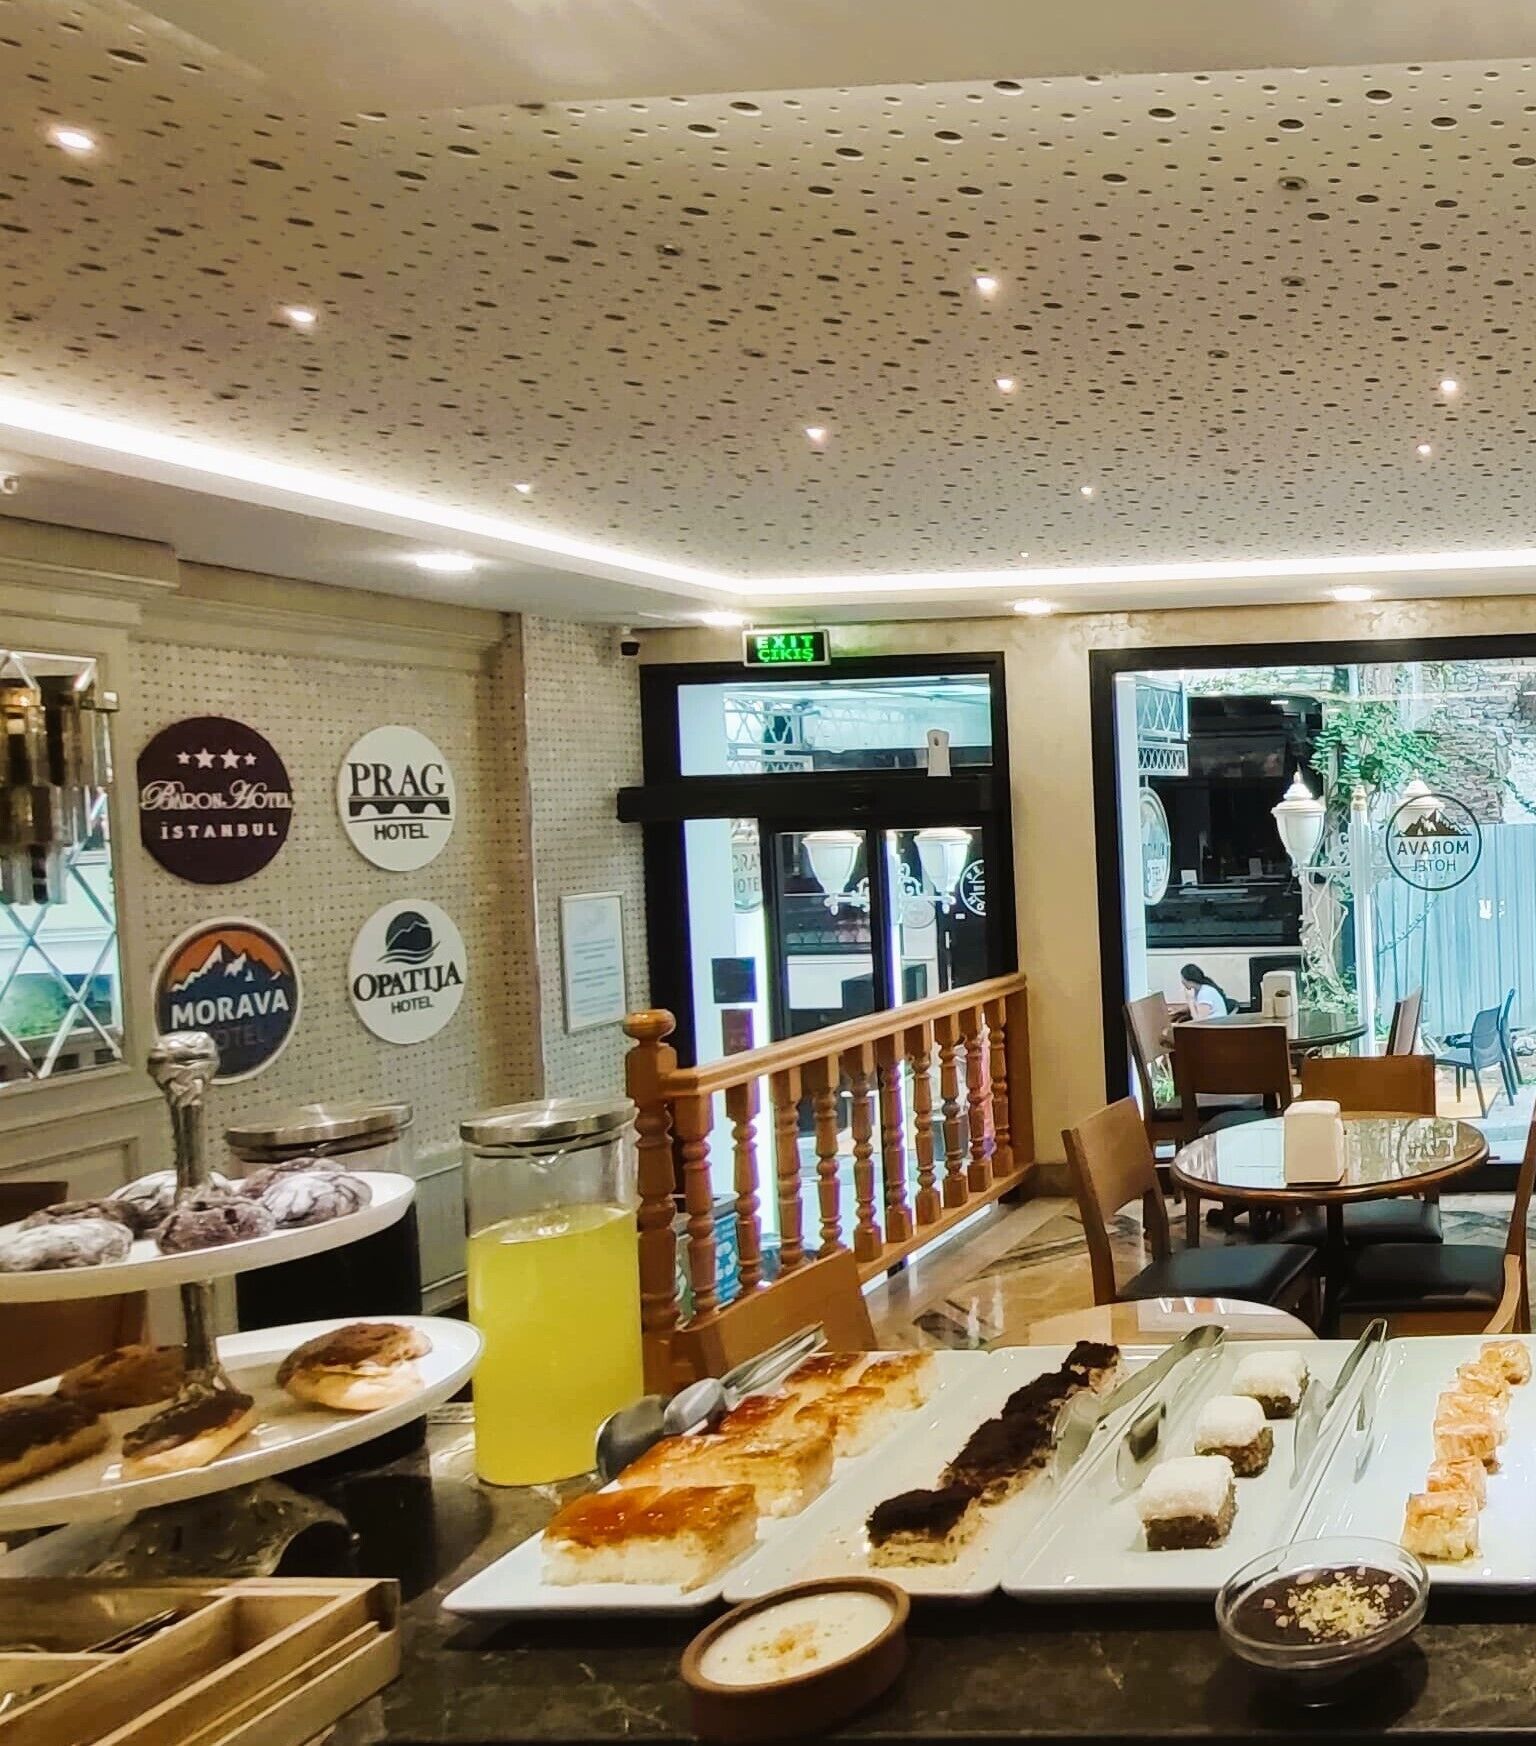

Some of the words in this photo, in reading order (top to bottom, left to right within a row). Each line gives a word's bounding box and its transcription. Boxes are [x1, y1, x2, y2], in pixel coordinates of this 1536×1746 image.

[756, 635, 814, 649] EXIT
[758, 648, 814, 662] ÇIKIŞ
[348, 763, 446, 797] PRAG
[374, 823, 429, 840] HOTEL
[353, 961, 464, 1001] OPATIJA
[171, 988, 289, 1029] MORAVA
[391, 997, 434, 1014] HOTEL
[213, 1023, 265, 1050] OTEL
